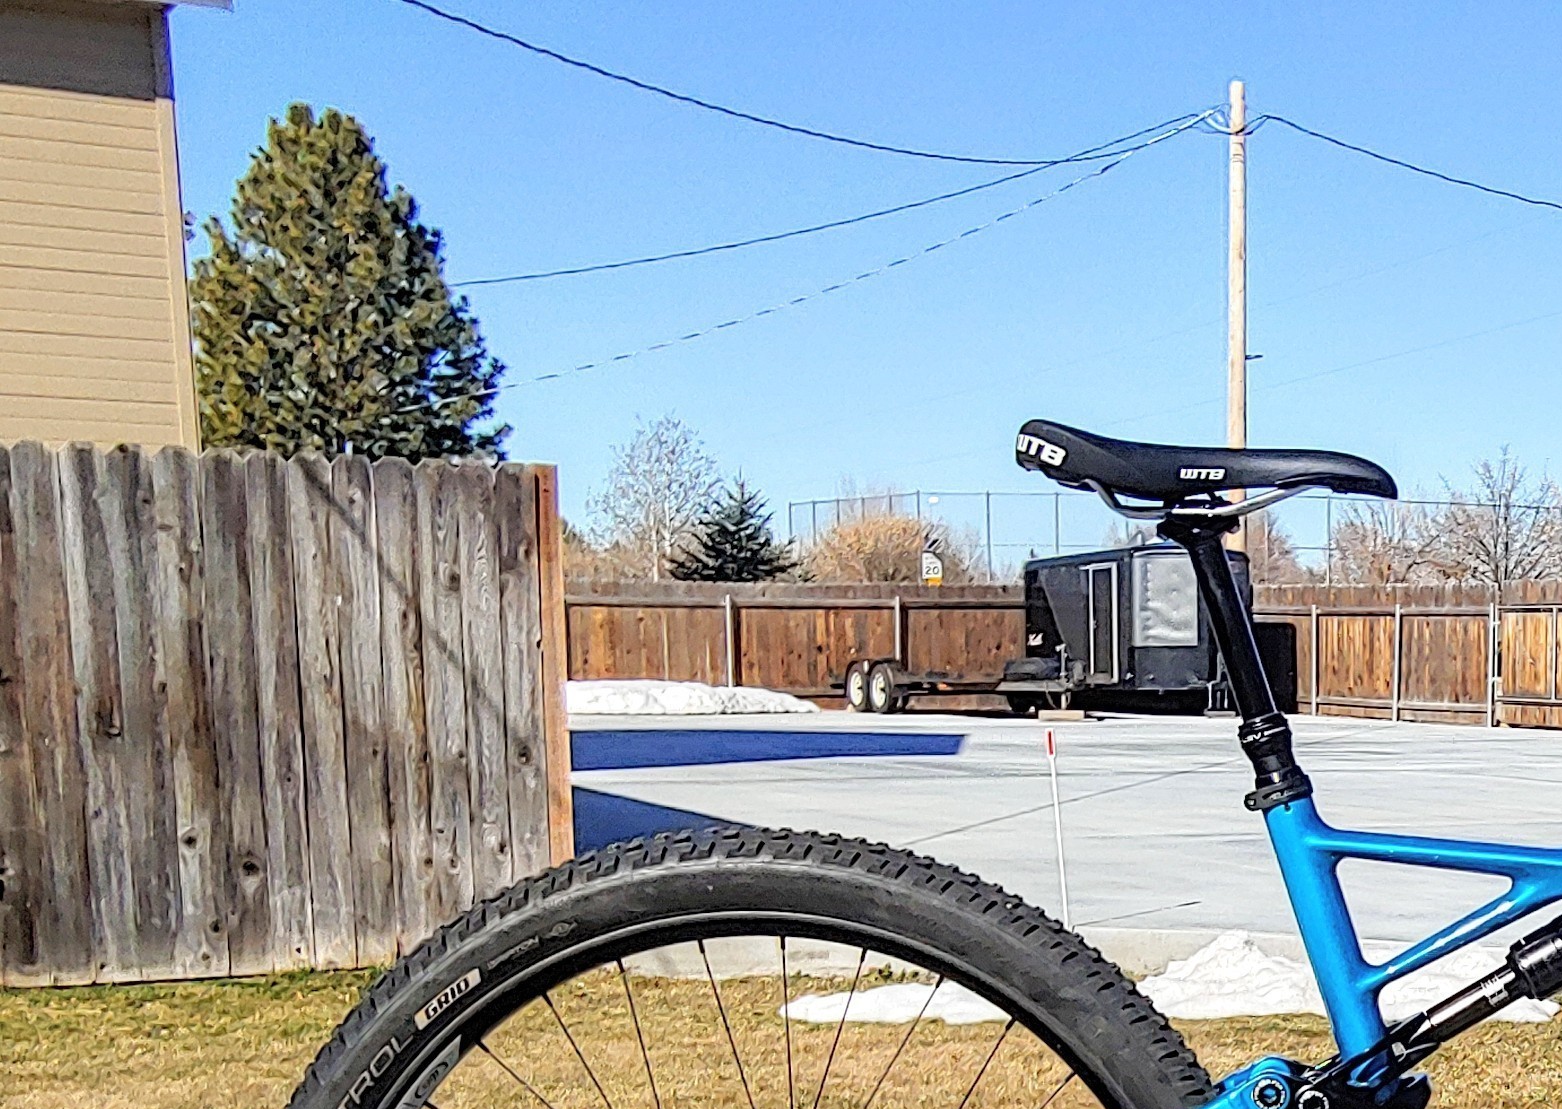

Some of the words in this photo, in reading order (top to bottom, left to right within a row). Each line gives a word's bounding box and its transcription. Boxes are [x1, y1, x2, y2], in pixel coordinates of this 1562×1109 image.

[1017, 434, 1066, 466] WTB
[1180, 468, 1226, 480] WTB
[925, 565, 940, 575] 20
[424, 977, 470, 1020] GRID
